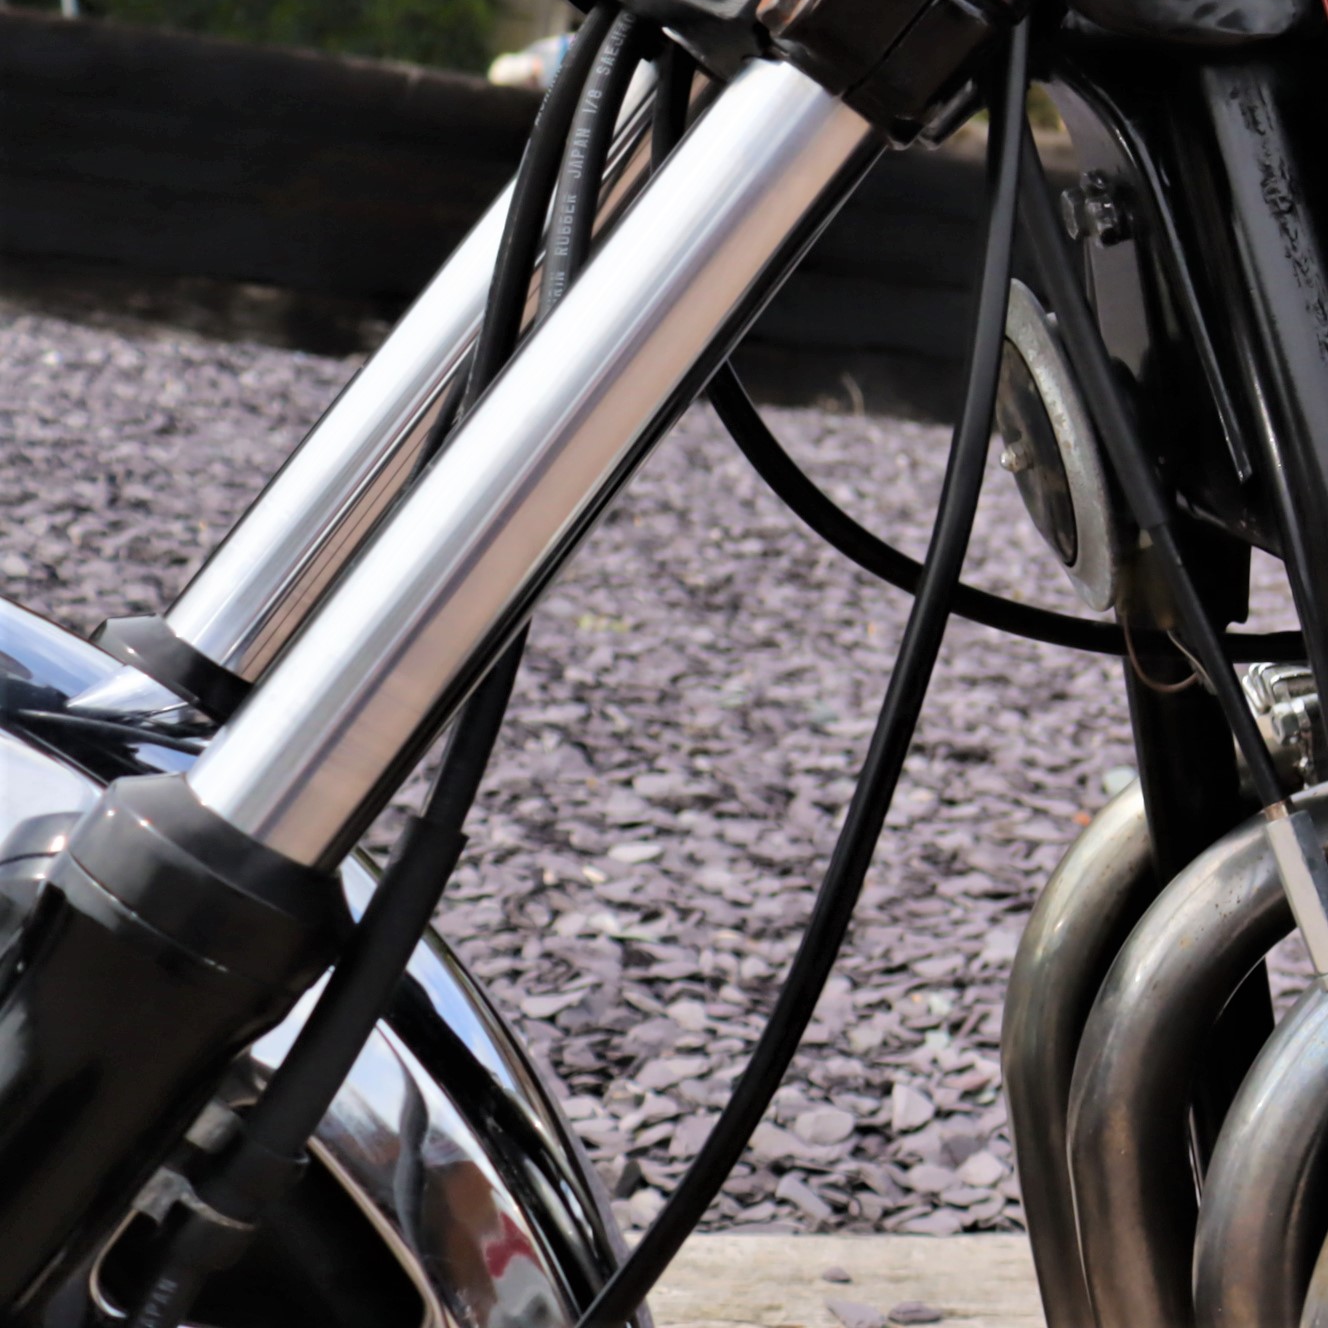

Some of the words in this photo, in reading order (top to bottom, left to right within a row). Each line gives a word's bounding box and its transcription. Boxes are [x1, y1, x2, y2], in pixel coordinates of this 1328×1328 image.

[554, 194, 577, 257] RUBBER
[568, 127, 591, 179] JAPAN
[582, 89, 603, 115] 1/8
